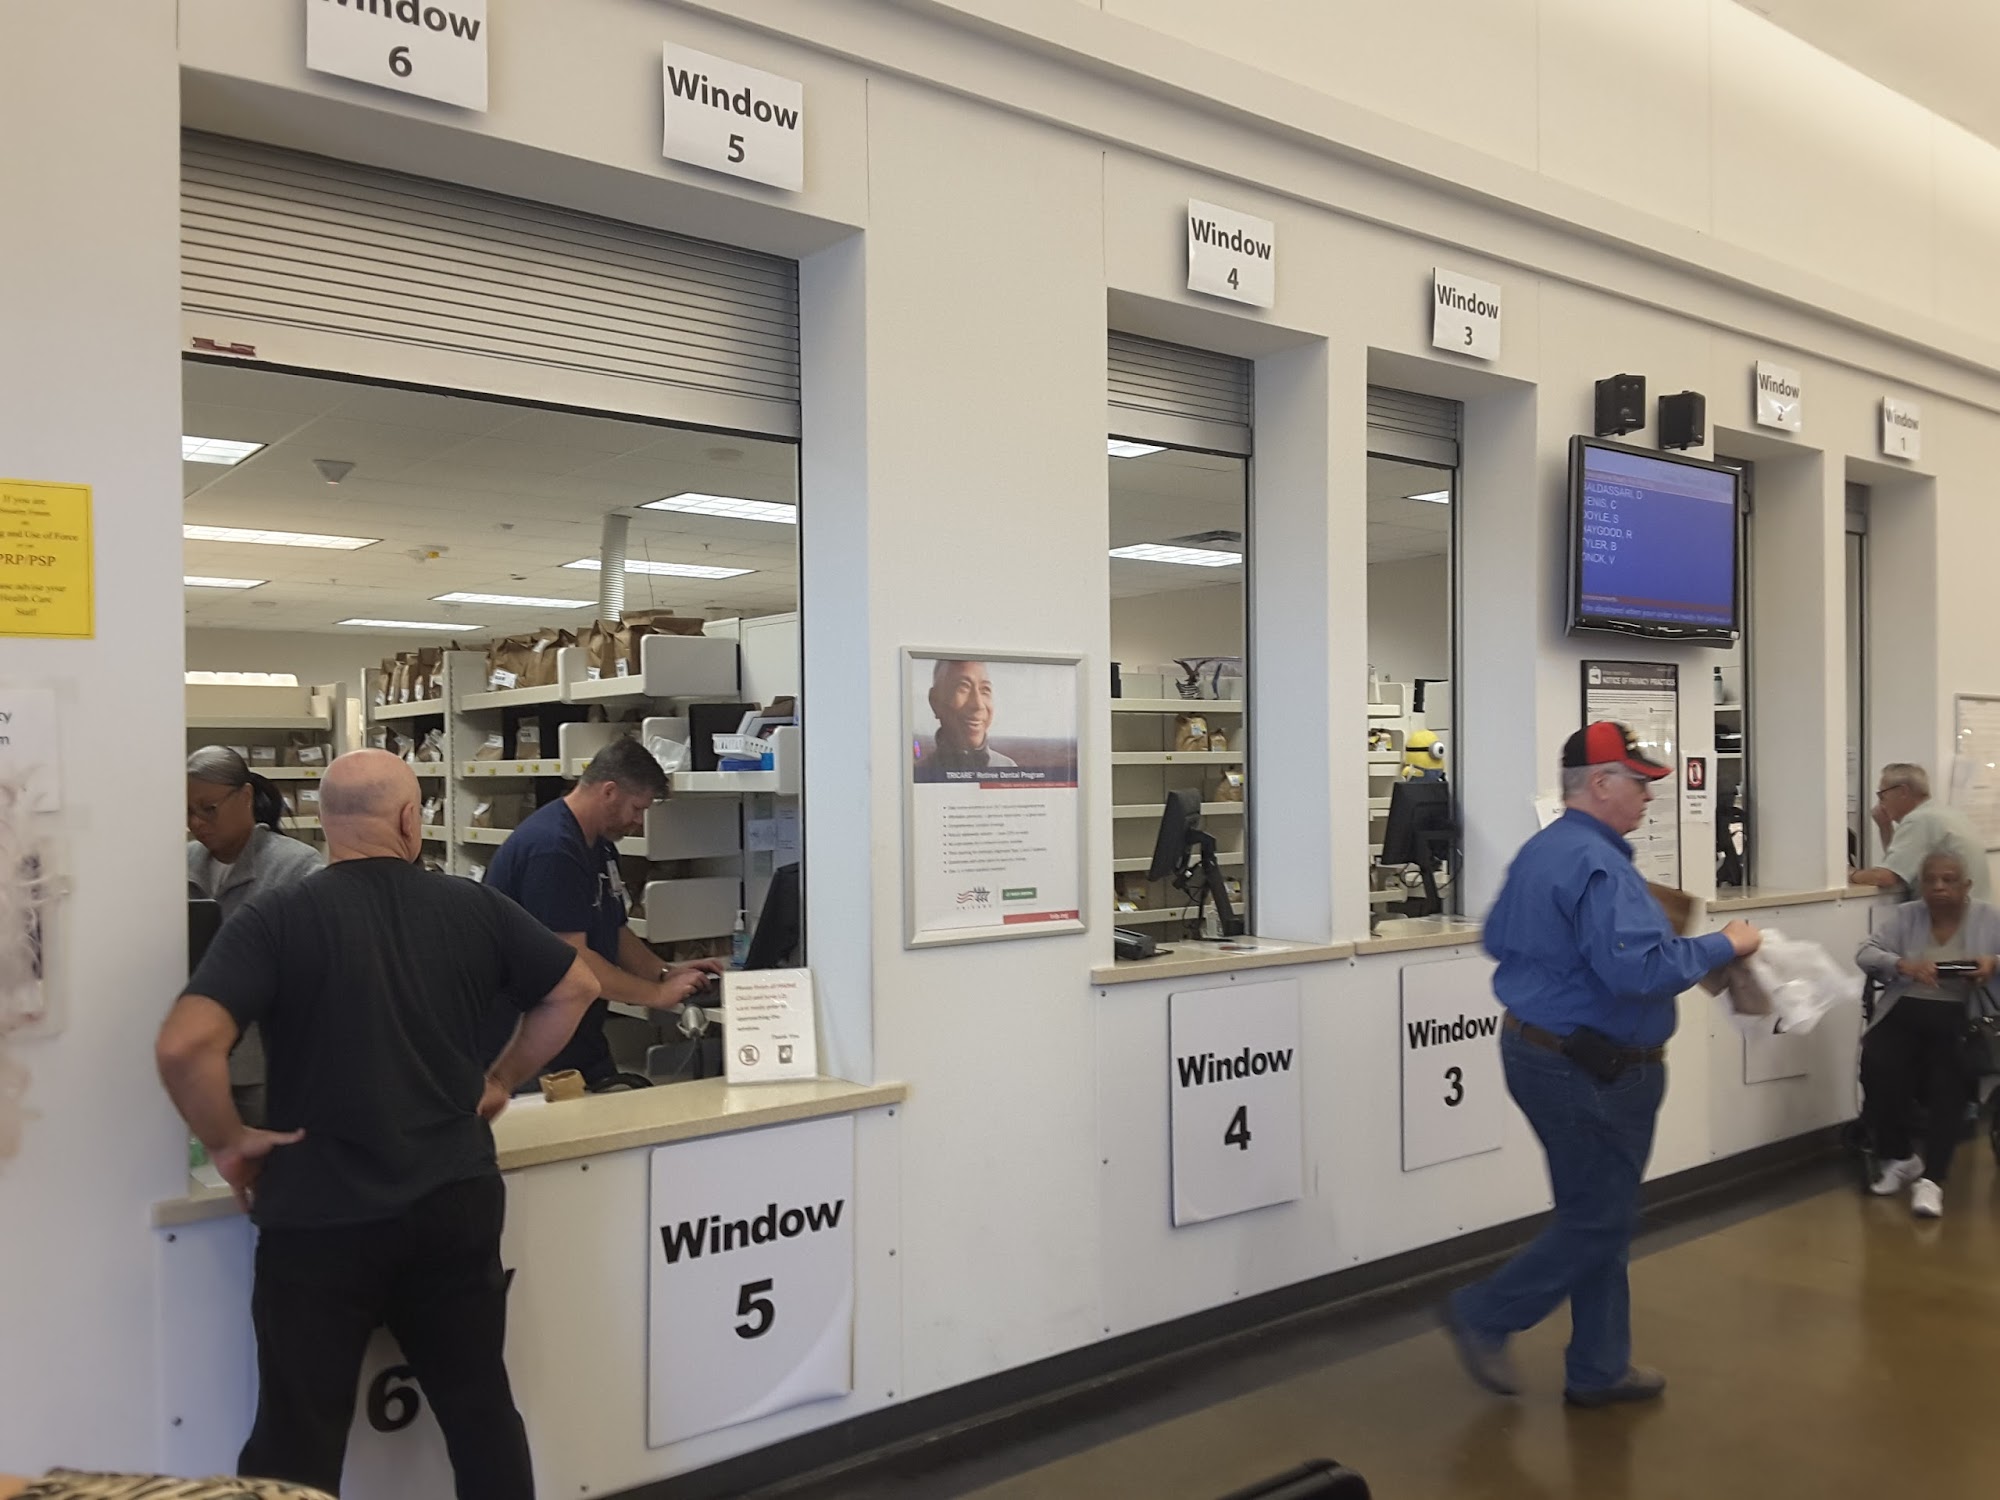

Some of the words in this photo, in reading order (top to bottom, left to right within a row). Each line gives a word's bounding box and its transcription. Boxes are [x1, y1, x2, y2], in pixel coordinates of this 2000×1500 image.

[322, 0, 480, 41] ndow
[388, 46, 413, 77] 6
[667, 65, 799, 131] Window
[727, 134, 745, 163] 5
[1191, 216, 1272, 260] Window
[1227, 267, 1239, 290] 4
[1437, 283, 1499, 320] Window
[1464, 326, 1473, 346] 3
[1758, 373, 1800, 399] Window
[1777, 405, 1784, 422] 2
[1885, 407, 1919, 431] Window
[1901, 437, 1906, 451] 1
[1611, 499, 1617, 510] C
[1613, 514, 1619, 524] S
[25, 531, 41, 539] Use
[43, 531, 53, 540] of
[54, 532, 79, 542] Force
[1611, 541, 1618, 551] B
[1626, 529, 1633, 540] R
[1609, 555, 1616, 565] V
[1000, 771, 1019, 779] Dental
[1021, 771, 1045, 779] Program
[1407, 1014, 1498, 1049] Window
[1177, 1046, 1294, 1088] Window
[1444, 1066, 1465, 1108] 3
[1224, 1105, 1252, 1151] 4
[660, 1199, 845, 1265] Window
[734, 1278, 776, 1340] 5
[366, 1365, 421, 1433] 6
